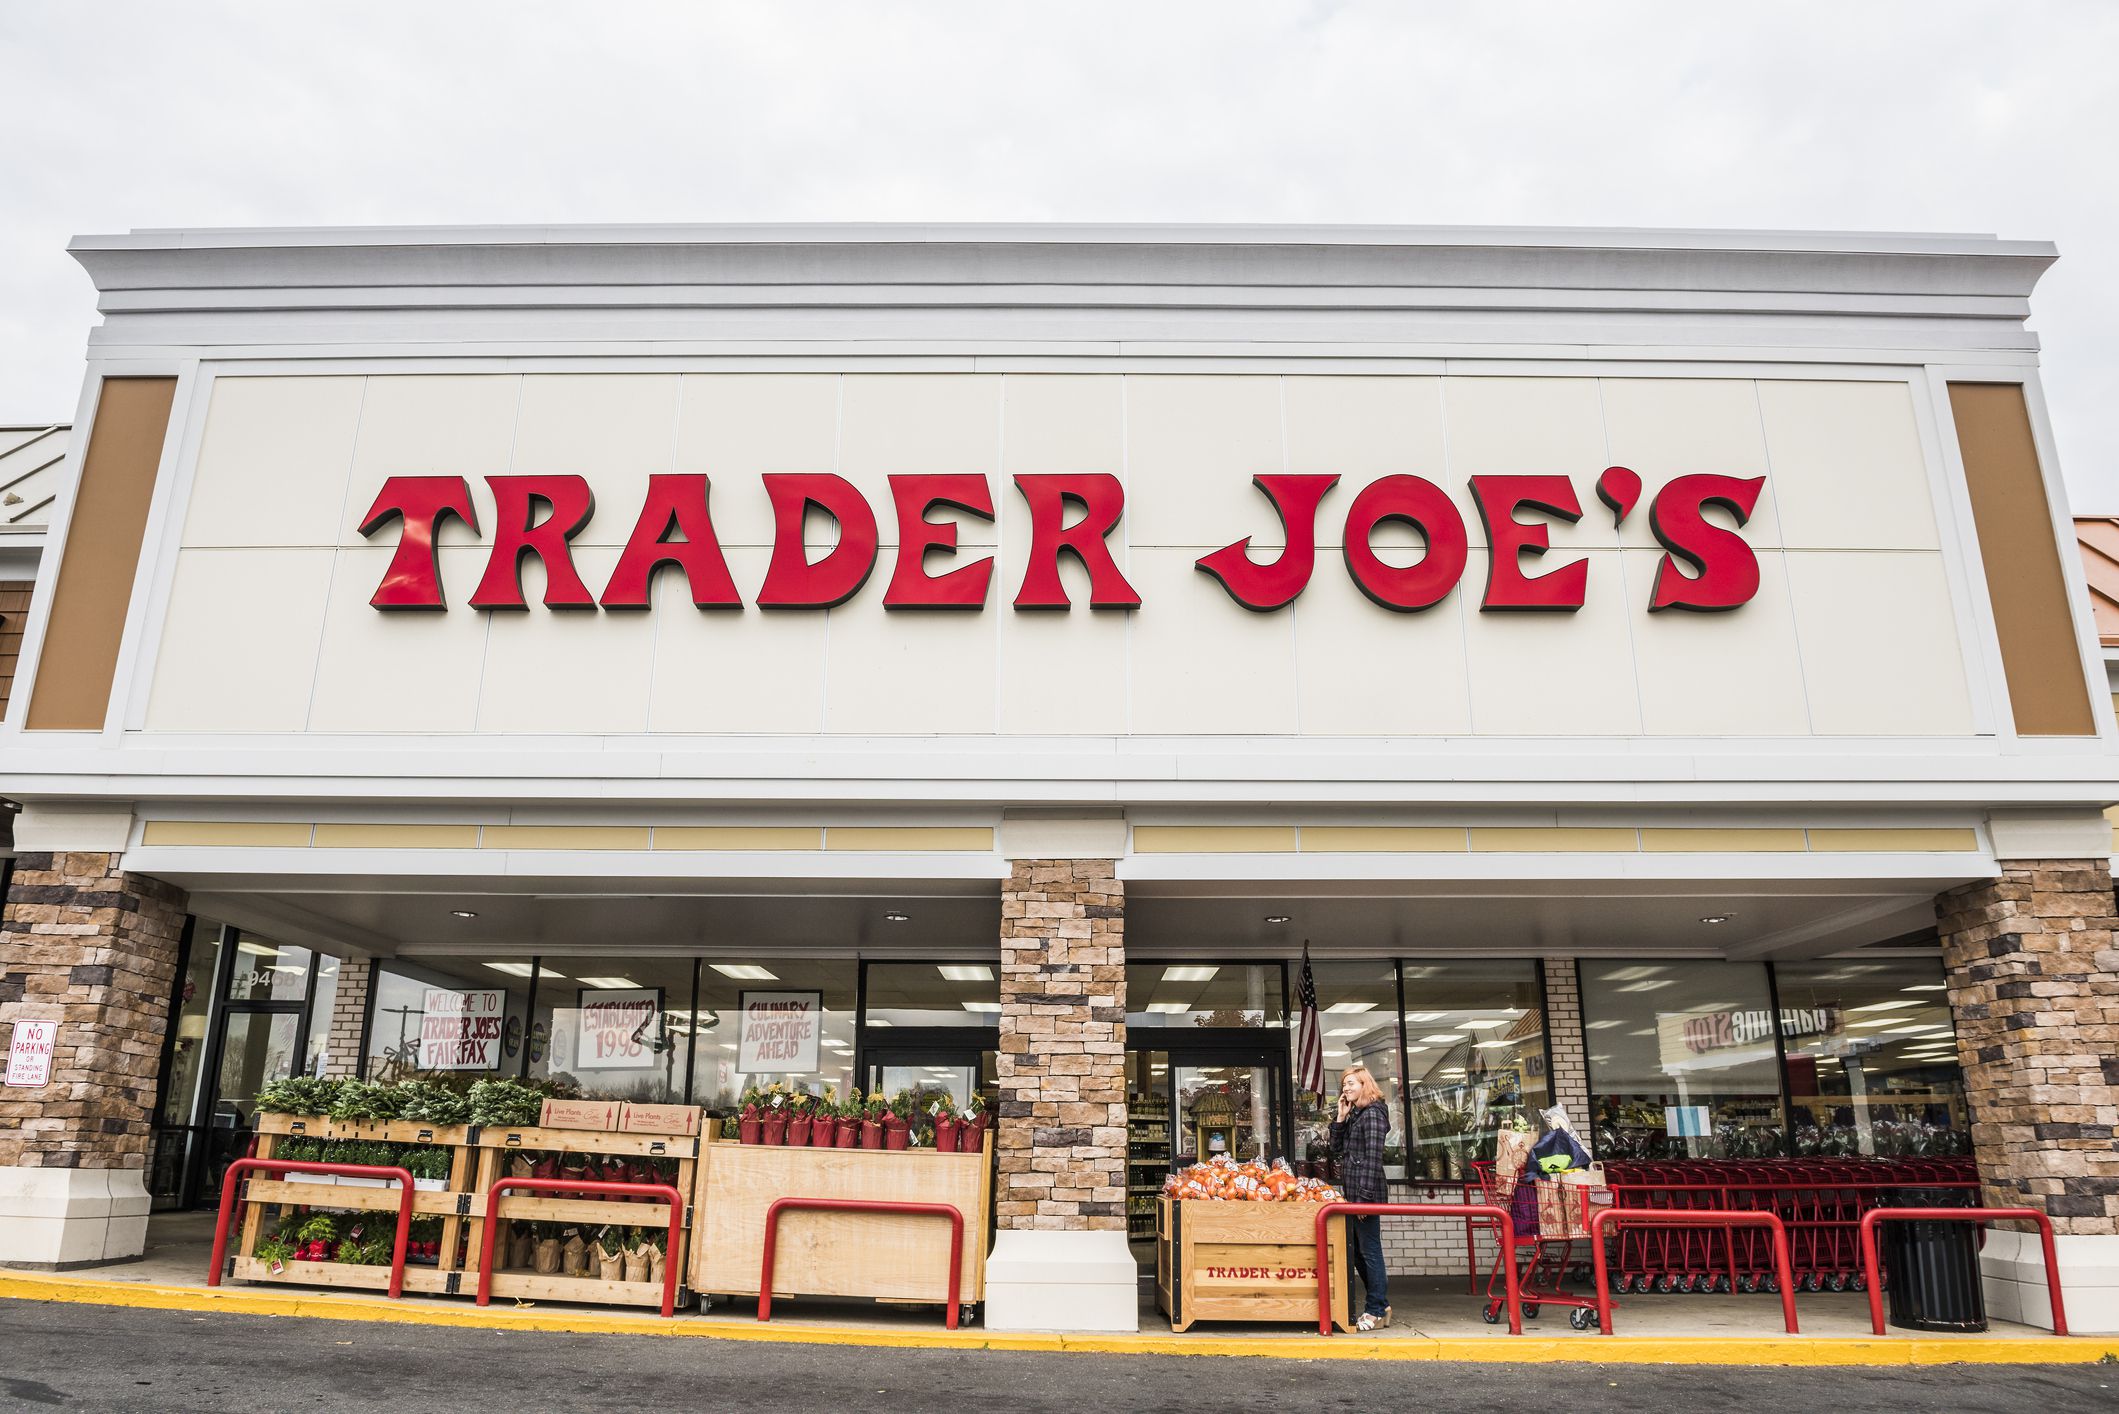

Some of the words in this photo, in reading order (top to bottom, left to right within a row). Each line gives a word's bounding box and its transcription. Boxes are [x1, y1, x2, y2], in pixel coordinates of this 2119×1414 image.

[357, 473, 1142, 611] TRADER
[1195, 466, 1766, 613] JOE'S
[429, 993, 477, 1012] WELCOME
[483, 993, 497, 1012] TO
[748, 1001, 810, 1021] CULINARY
[27, 1028, 43, 1040] NO
[423, 1016, 470, 1040] TRADER
[471, 1016, 501, 1040] JOES
[746, 1021, 812, 1042] ADVENTURE
[15, 1042, 50, 1055] PARKING
[427, 1039, 488, 1065] FAIRFAX
[756, 1040, 799, 1060] AHEAD
[566, 1108, 582, 1116] Plants
[645, 1112, 661, 1120] Plants
[1207, 1267, 1270, 1278] TRADER
[1275, 1267, 1318, 1280] JOE'S
